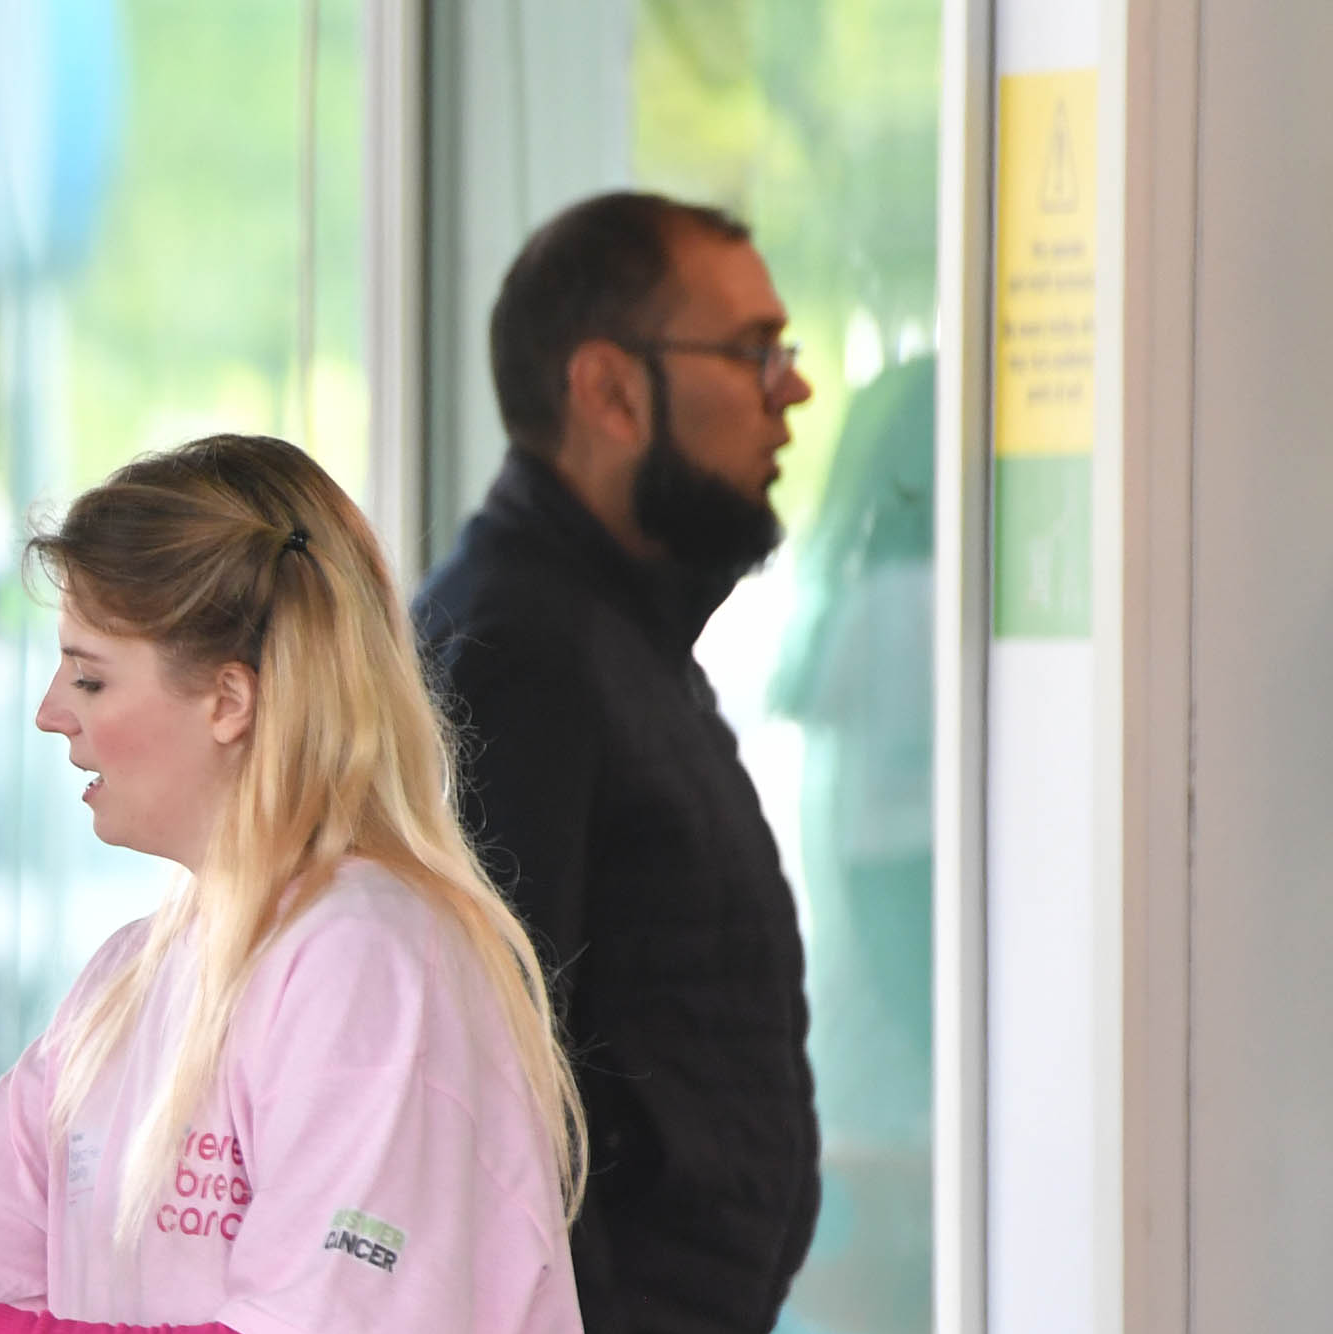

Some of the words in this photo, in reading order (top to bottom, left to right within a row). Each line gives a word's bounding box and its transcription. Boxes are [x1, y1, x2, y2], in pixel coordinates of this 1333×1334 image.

[183, 1131, 244, 1166] reve
[175, 1160, 252, 1205] brea
[156, 1204, 242, 1241] canc
